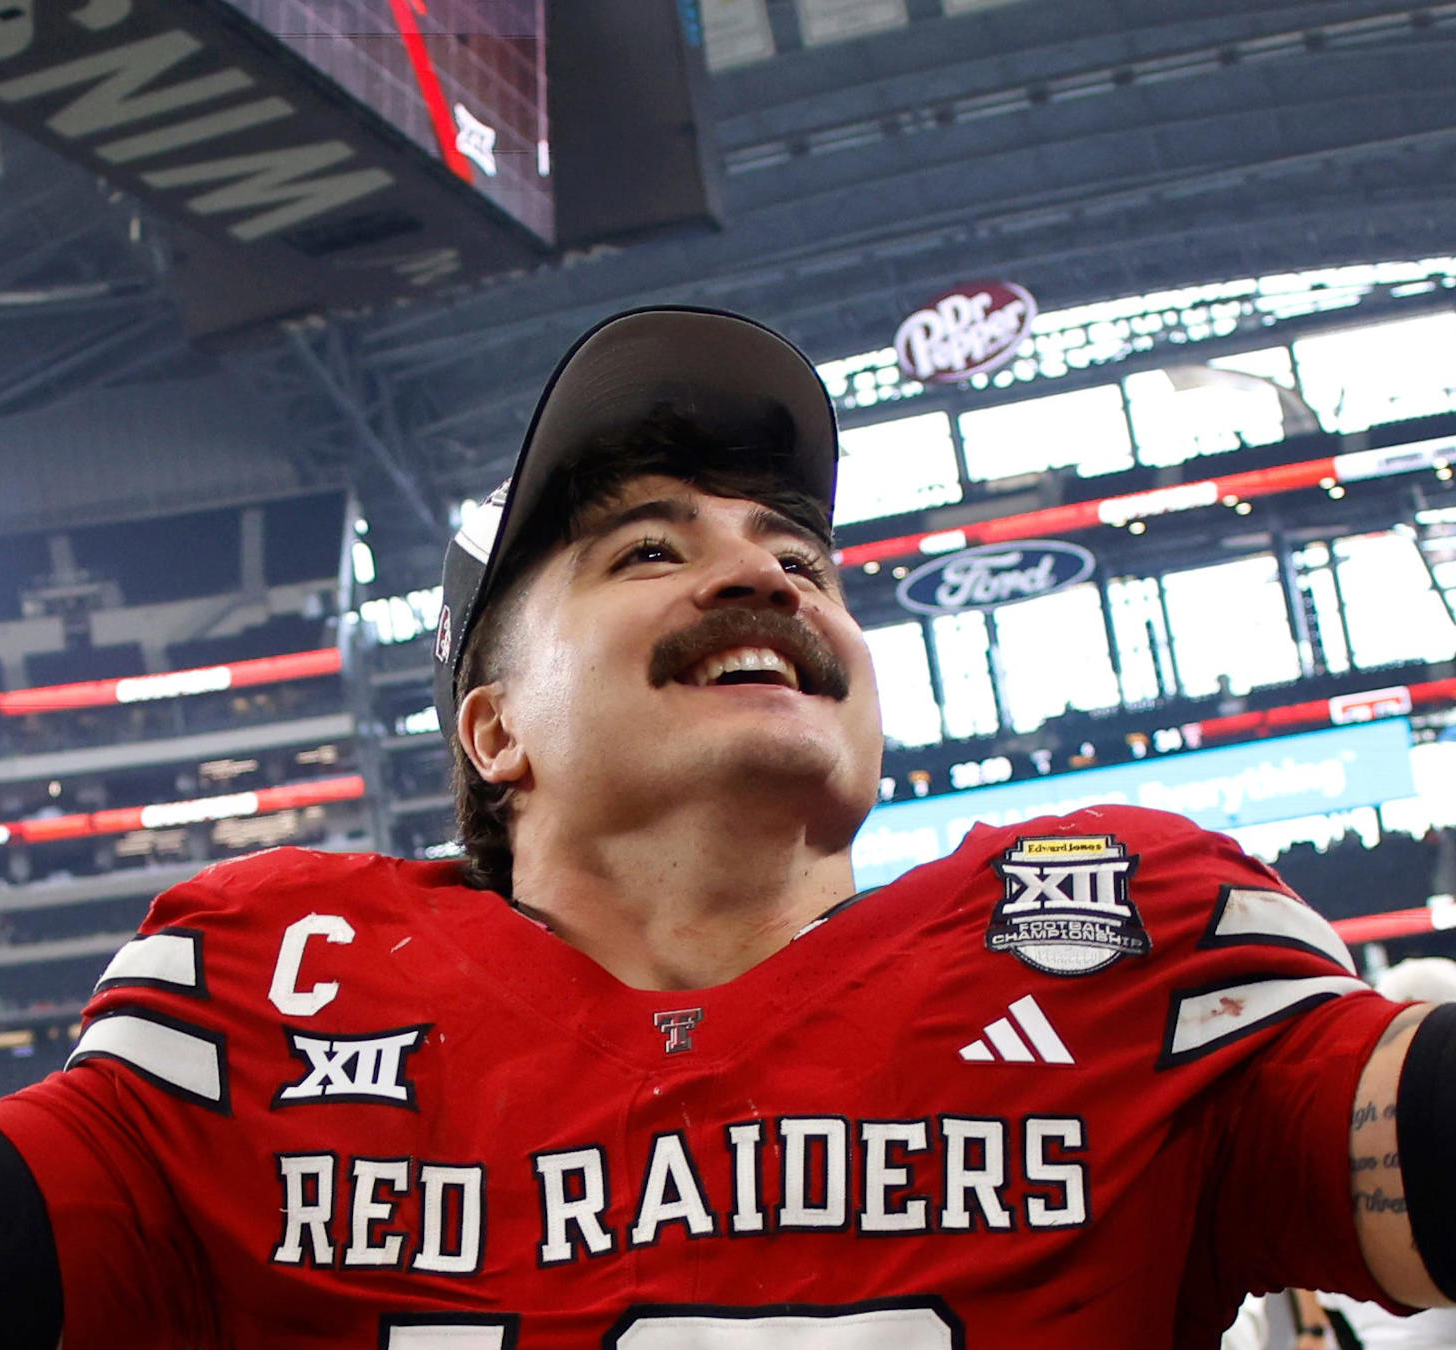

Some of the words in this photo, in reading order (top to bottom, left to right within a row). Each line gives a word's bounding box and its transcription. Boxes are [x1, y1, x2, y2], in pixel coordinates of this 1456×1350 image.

[907, 299, 1025, 378] Pepper
[937, 292, 993, 334] Dr
[936, 551, 1057, 608] Ford
[1001, 861, 1132, 917] XII
[992, 929, 1144, 948] CHAMPIONSHIP
[1018, 920, 1117, 936] FOOTBALL
[268, 912, 356, 1017] C
[279, 1030, 419, 1101] XII
[272, 1155, 484, 1273] RED
[535, 1116, 1088, 1265] RAIDERS
